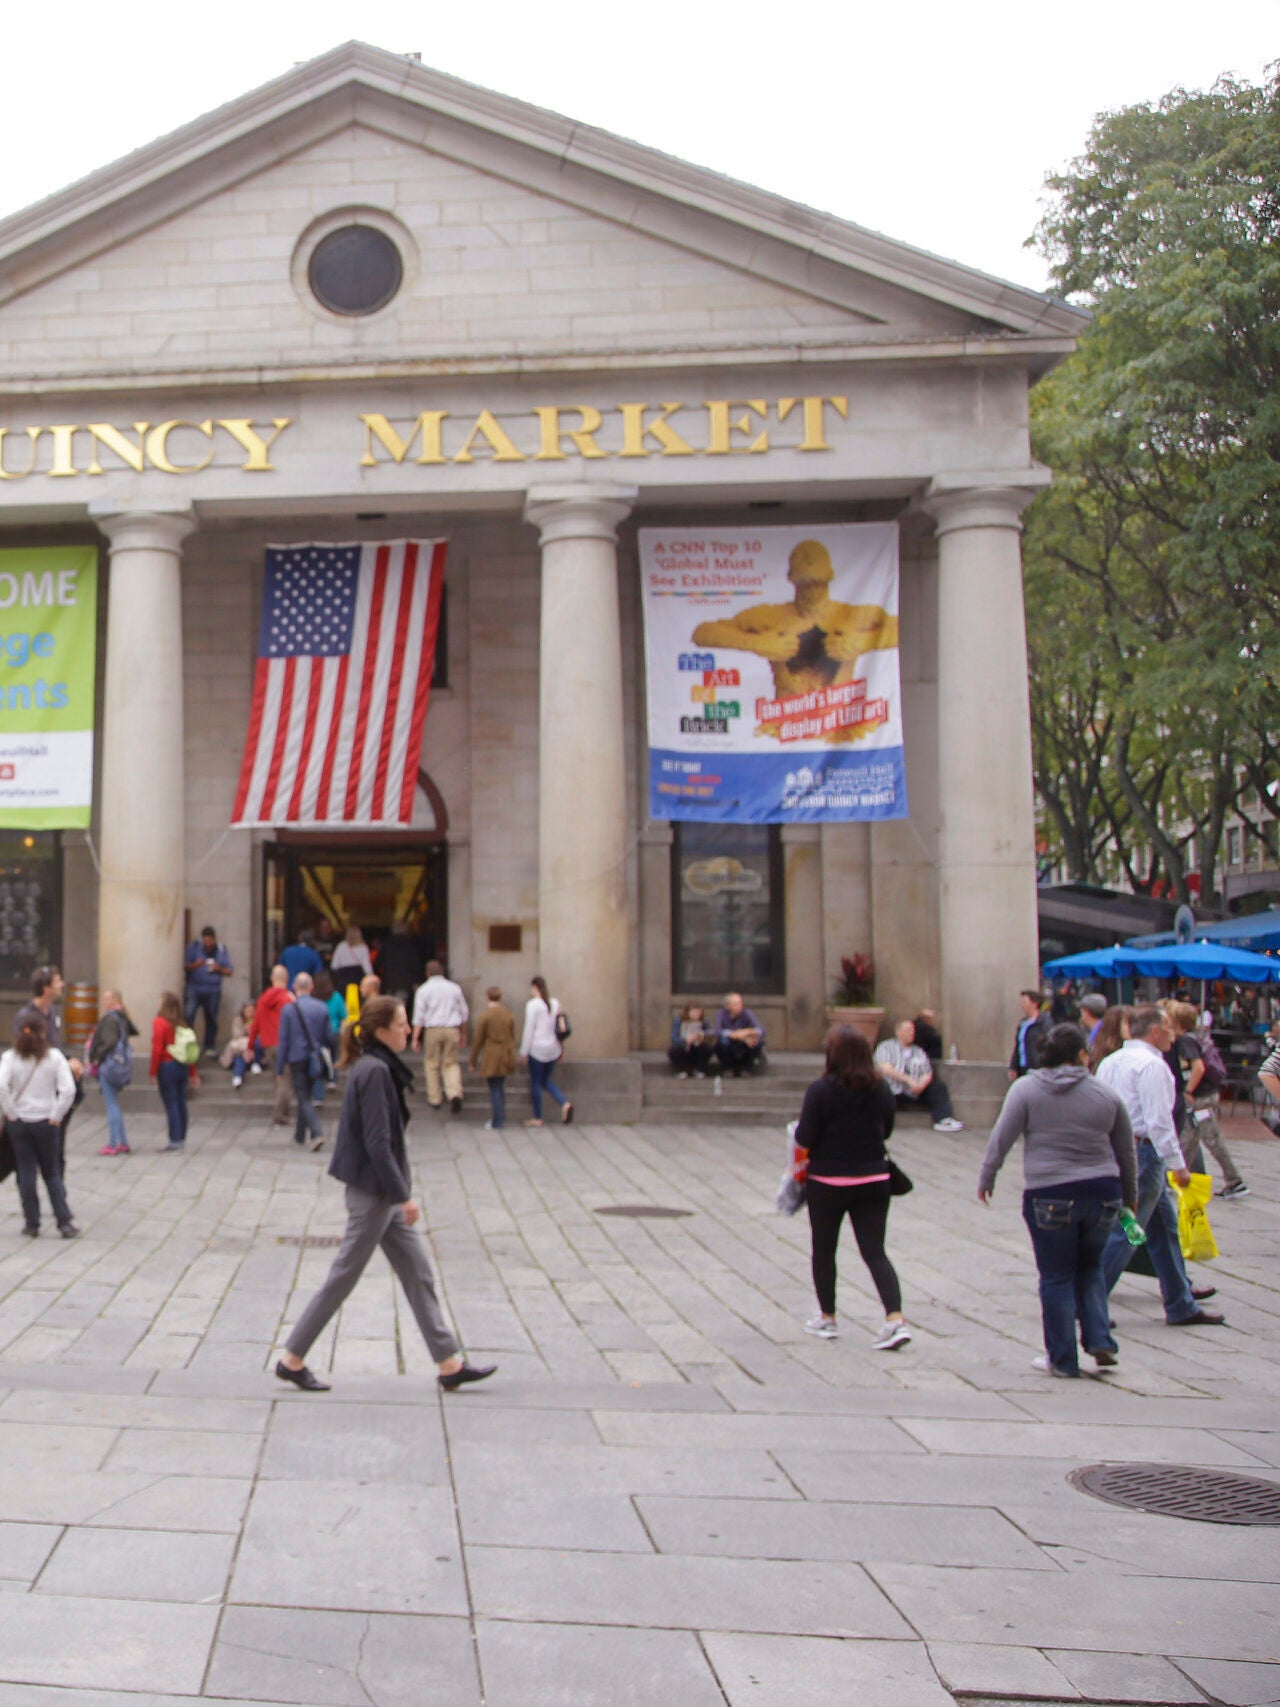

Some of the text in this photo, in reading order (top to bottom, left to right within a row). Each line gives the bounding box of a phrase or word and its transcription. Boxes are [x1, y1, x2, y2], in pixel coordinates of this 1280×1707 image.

[358, 395, 849, 467] MARKET
[654, 540, 762, 557] A CNN Top 10
[714, 557, 755, 571] Must
[650, 573, 677, 587] See
[680, 655, 713, 670] The
[708, 670, 736, 687] Art
[707, 703, 737, 719] the
[783, 690, 826, 715] world's
[781, 717, 823, 740] display
[823, 710, 839, 730] of
